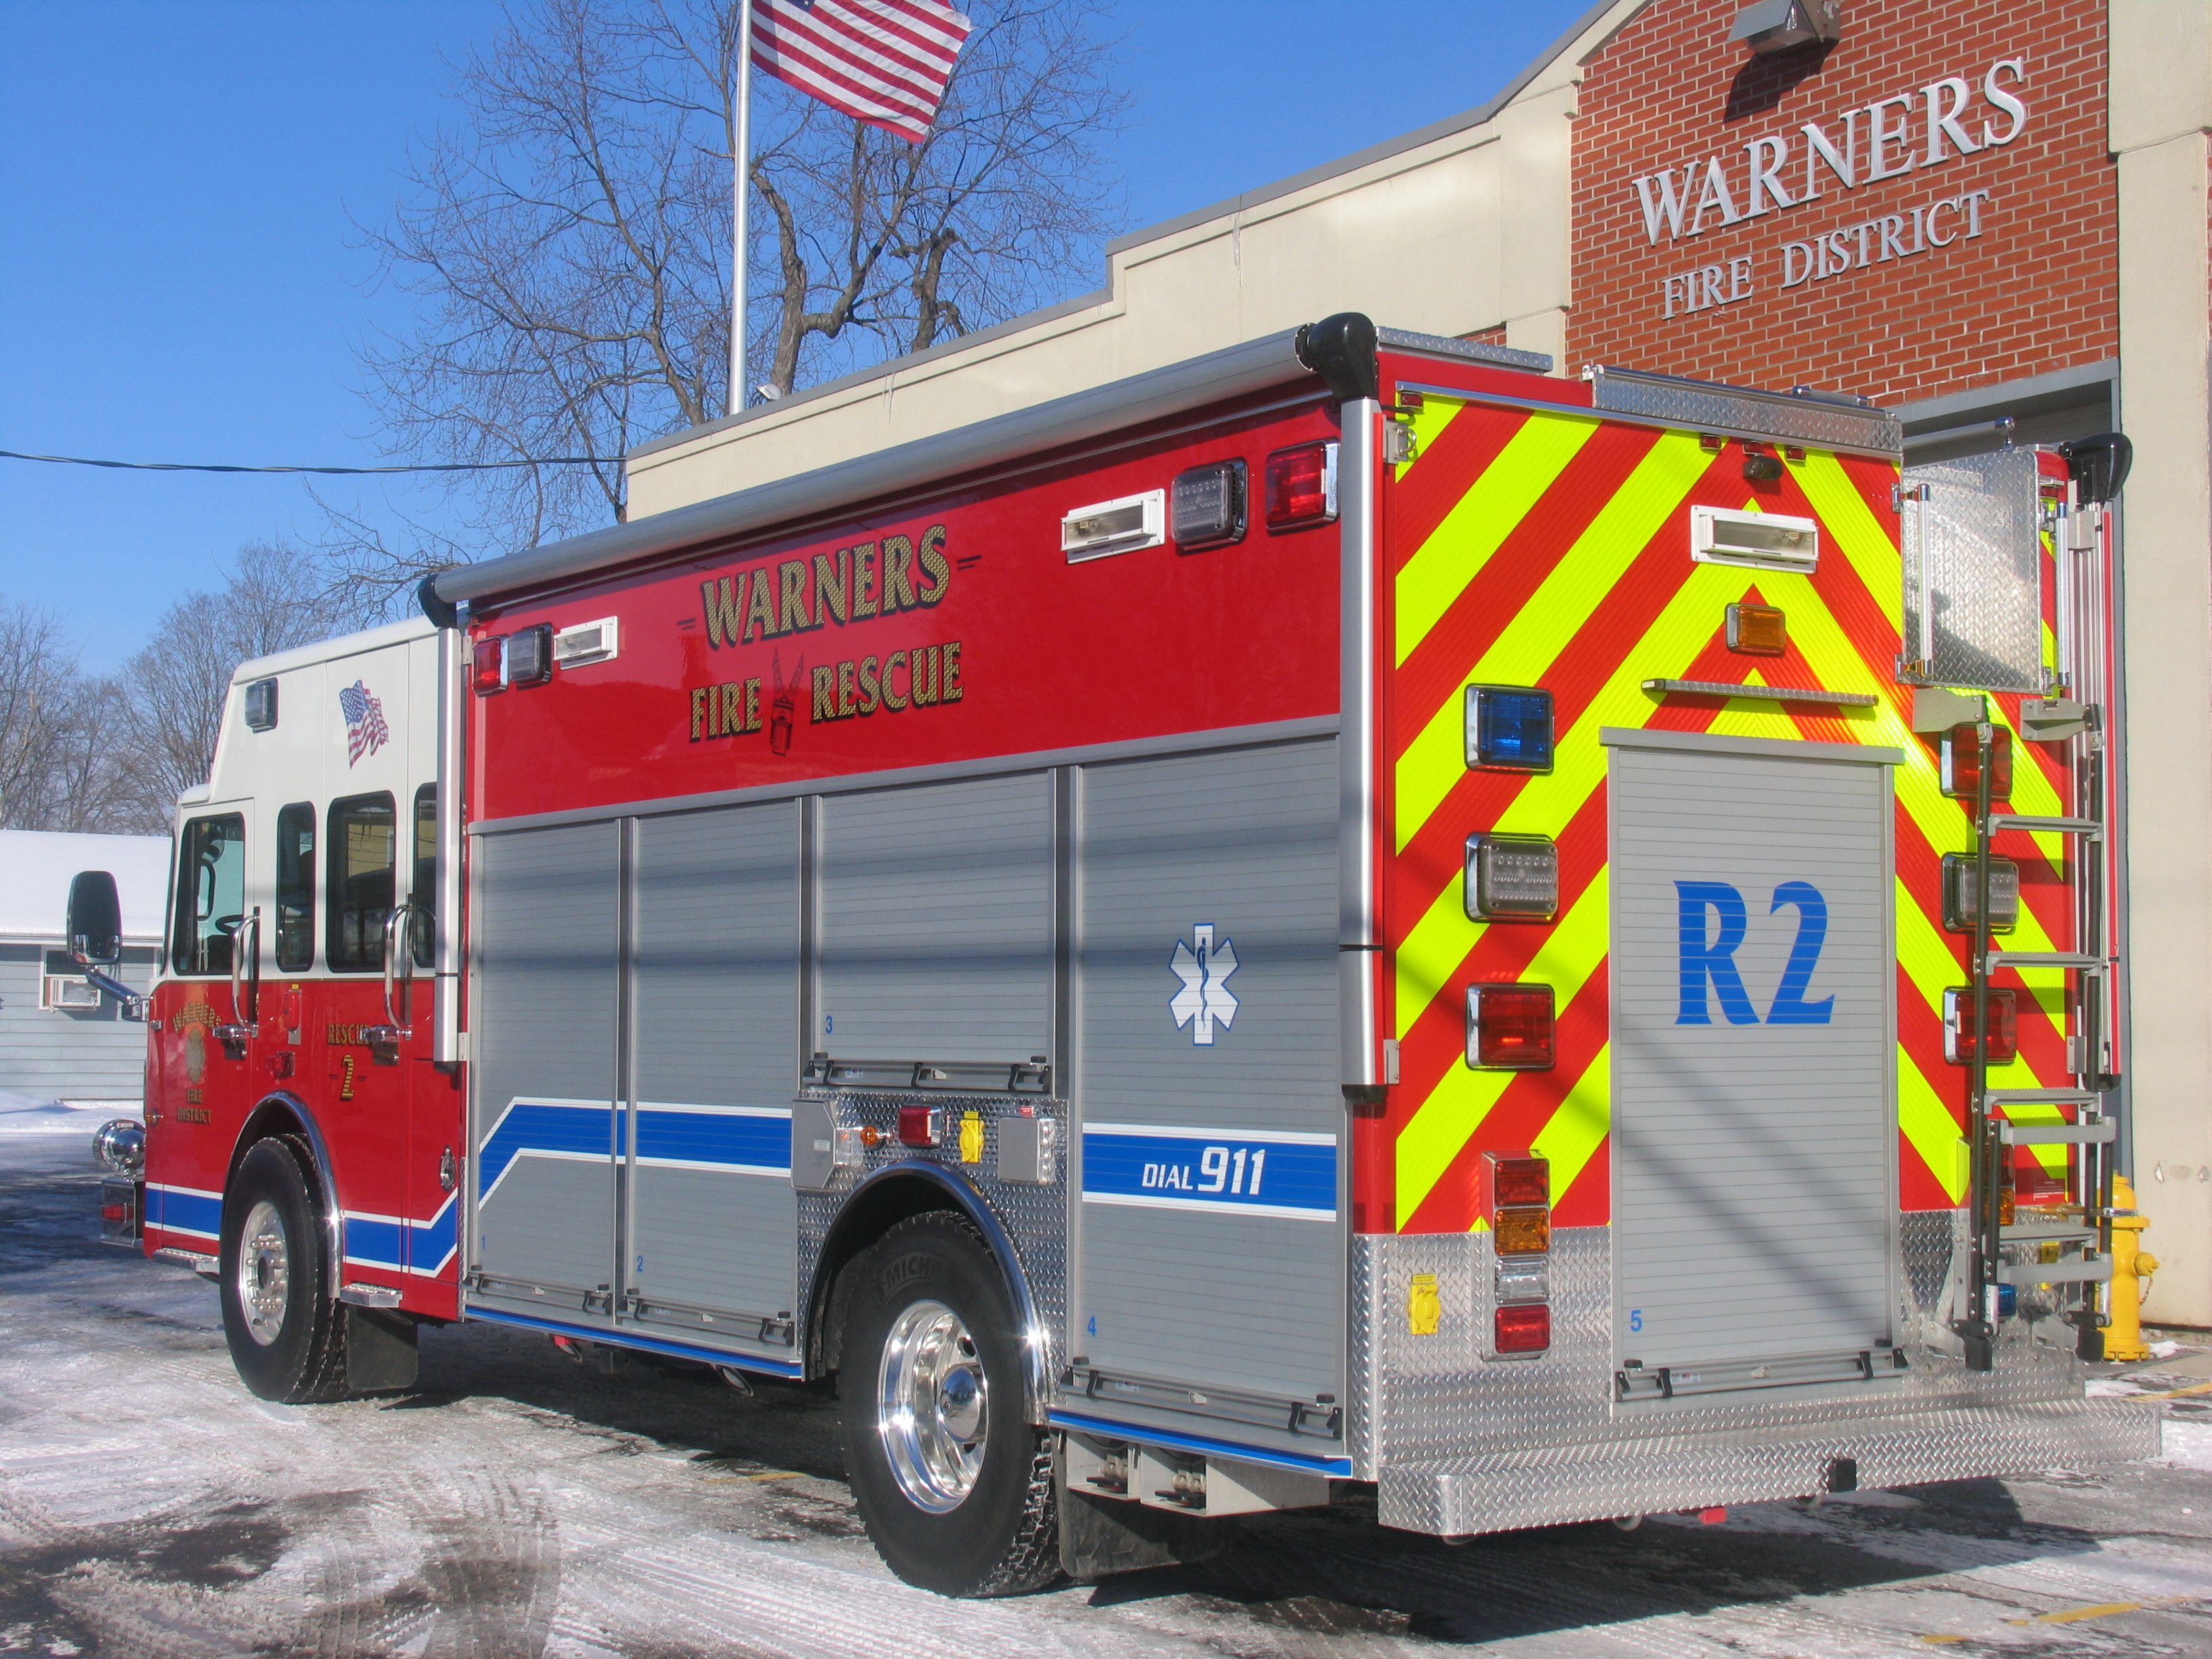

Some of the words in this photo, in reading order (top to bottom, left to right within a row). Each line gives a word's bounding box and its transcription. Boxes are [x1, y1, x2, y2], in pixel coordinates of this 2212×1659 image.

[1632, 56, 2027, 246] WARNERS
[1662, 256, 1754, 321] FIRE
[1780, 189, 1990, 289] DISTRICT
[701, 524, 950, 649] WARNERS
[690, 677, 763, 742] FIRE
[811, 641, 964, 724] RESCUE
[1673, 880, 1835, 1025] R2
[825, 1016, 832, 1033] 3
[186, 1089, 202, 1104] FIRE
[341, 1054, 354, 1101] 2
[178, 1107, 212, 1124] DISTRICT
[1142, 1163, 1193, 1190] DIAL
[1197, 1146, 1265, 1195] 911
[638, 1255, 643, 1272] 2
[1087, 1316, 1097, 1336] 4
[1630, 1309, 1643, 1332] 5
